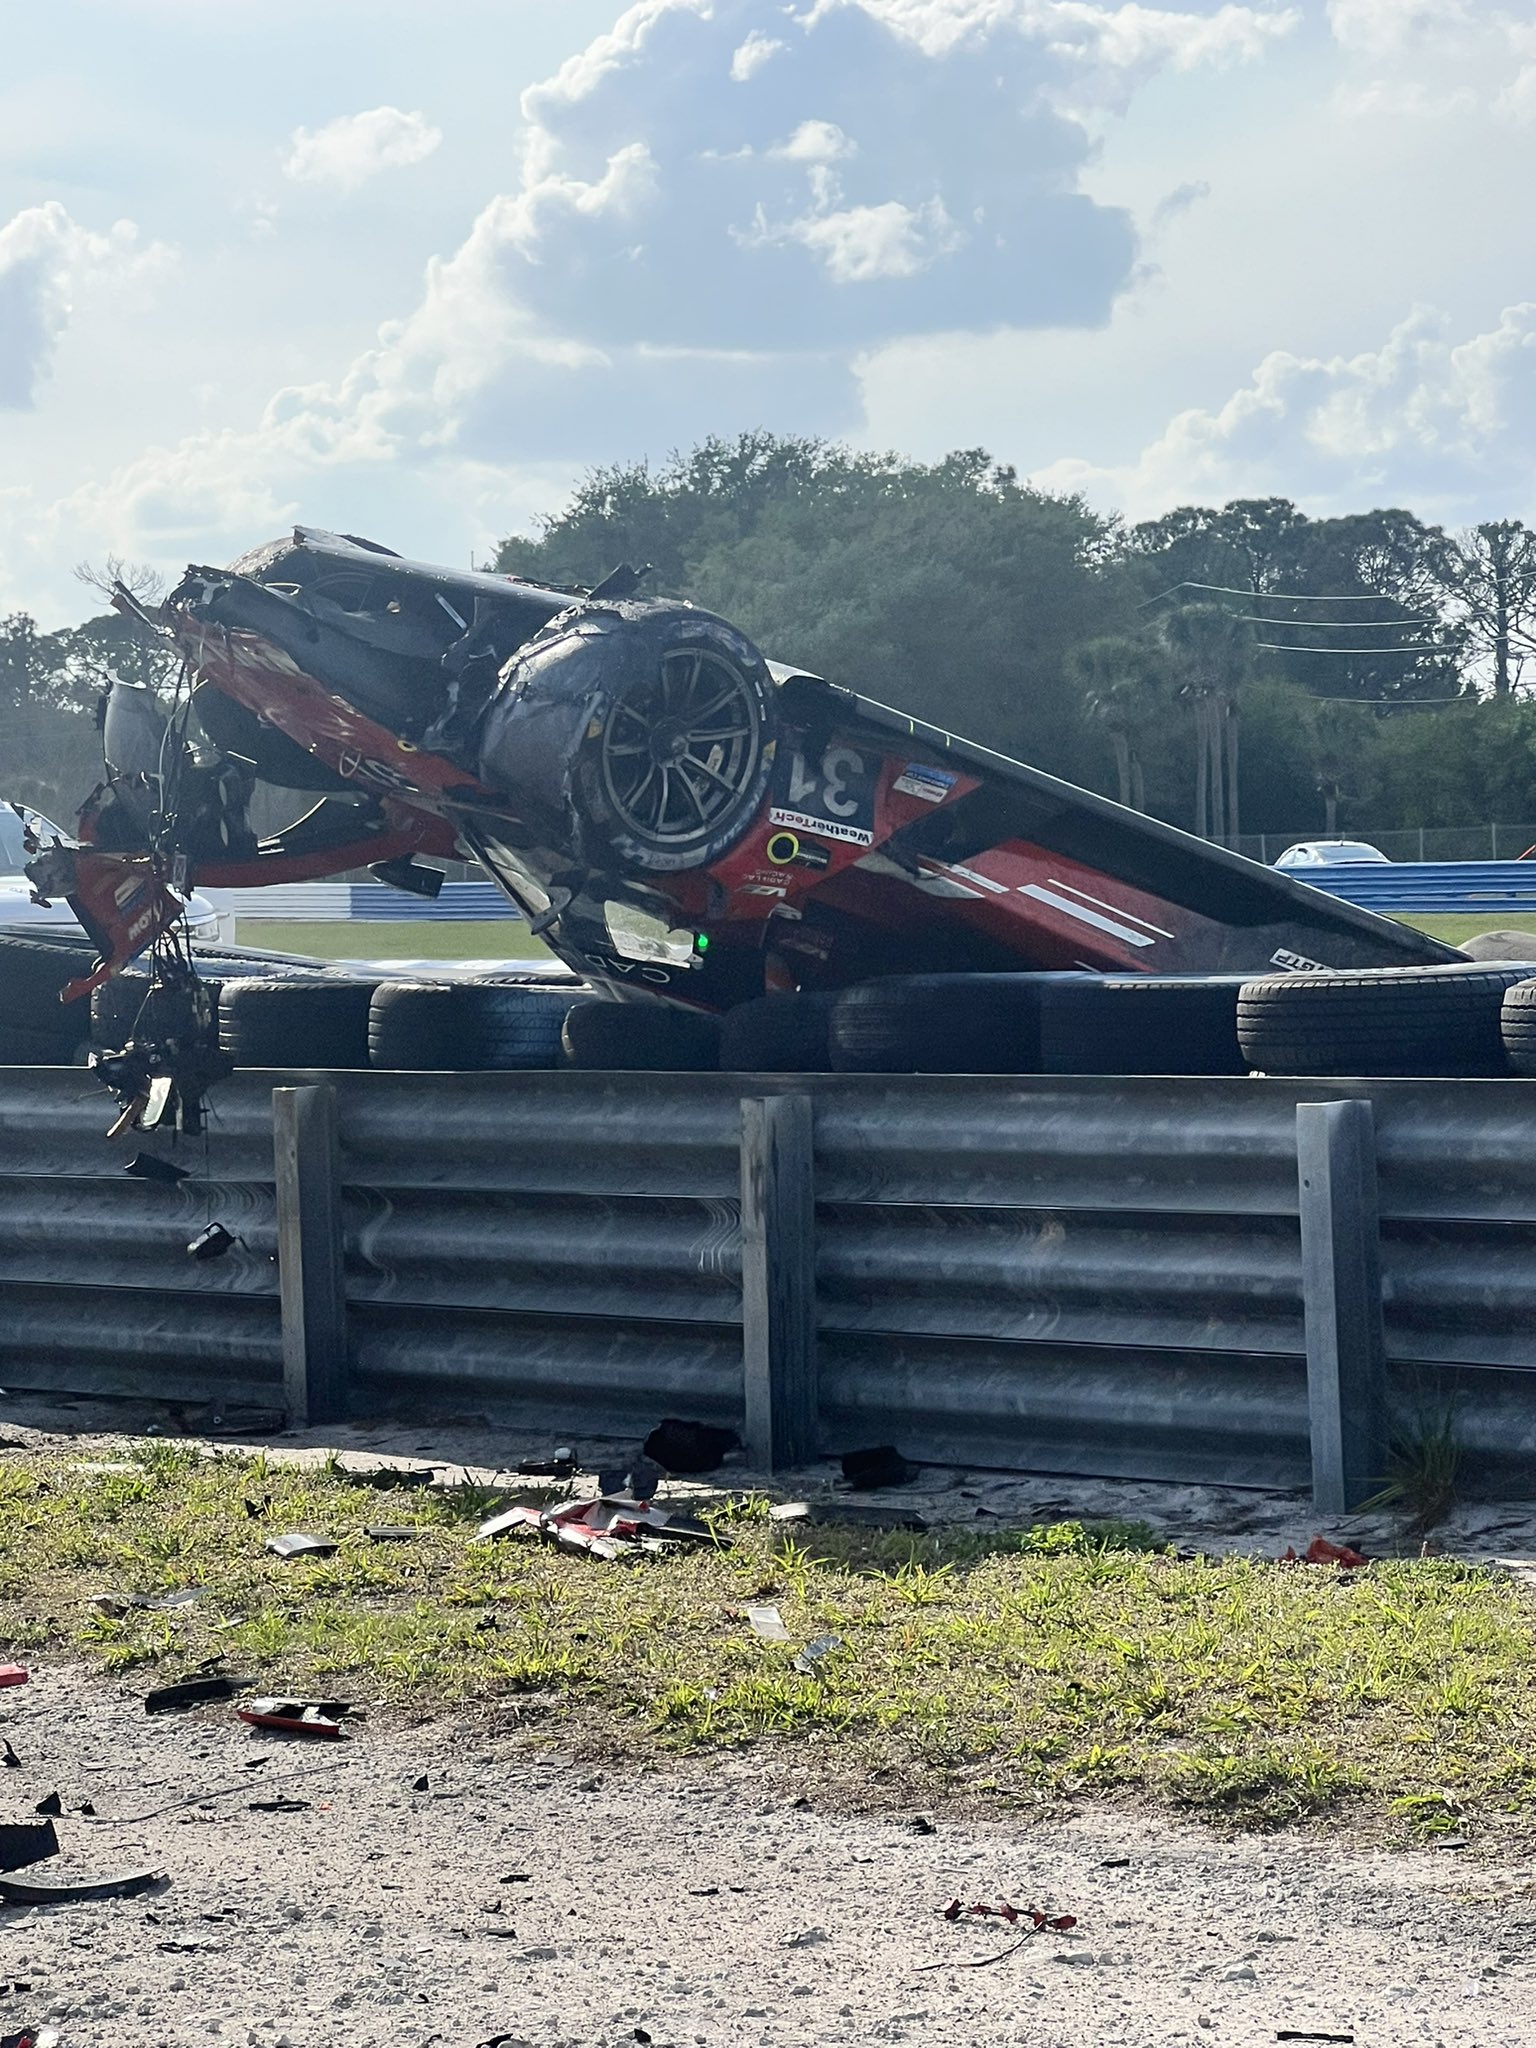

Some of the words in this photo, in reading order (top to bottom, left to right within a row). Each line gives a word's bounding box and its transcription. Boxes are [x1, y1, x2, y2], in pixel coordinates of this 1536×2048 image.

[789, 748, 864, 817] 31
[775, 811, 870, 844] WeatherTech
[1275, 954, 1315, 971] GTP
